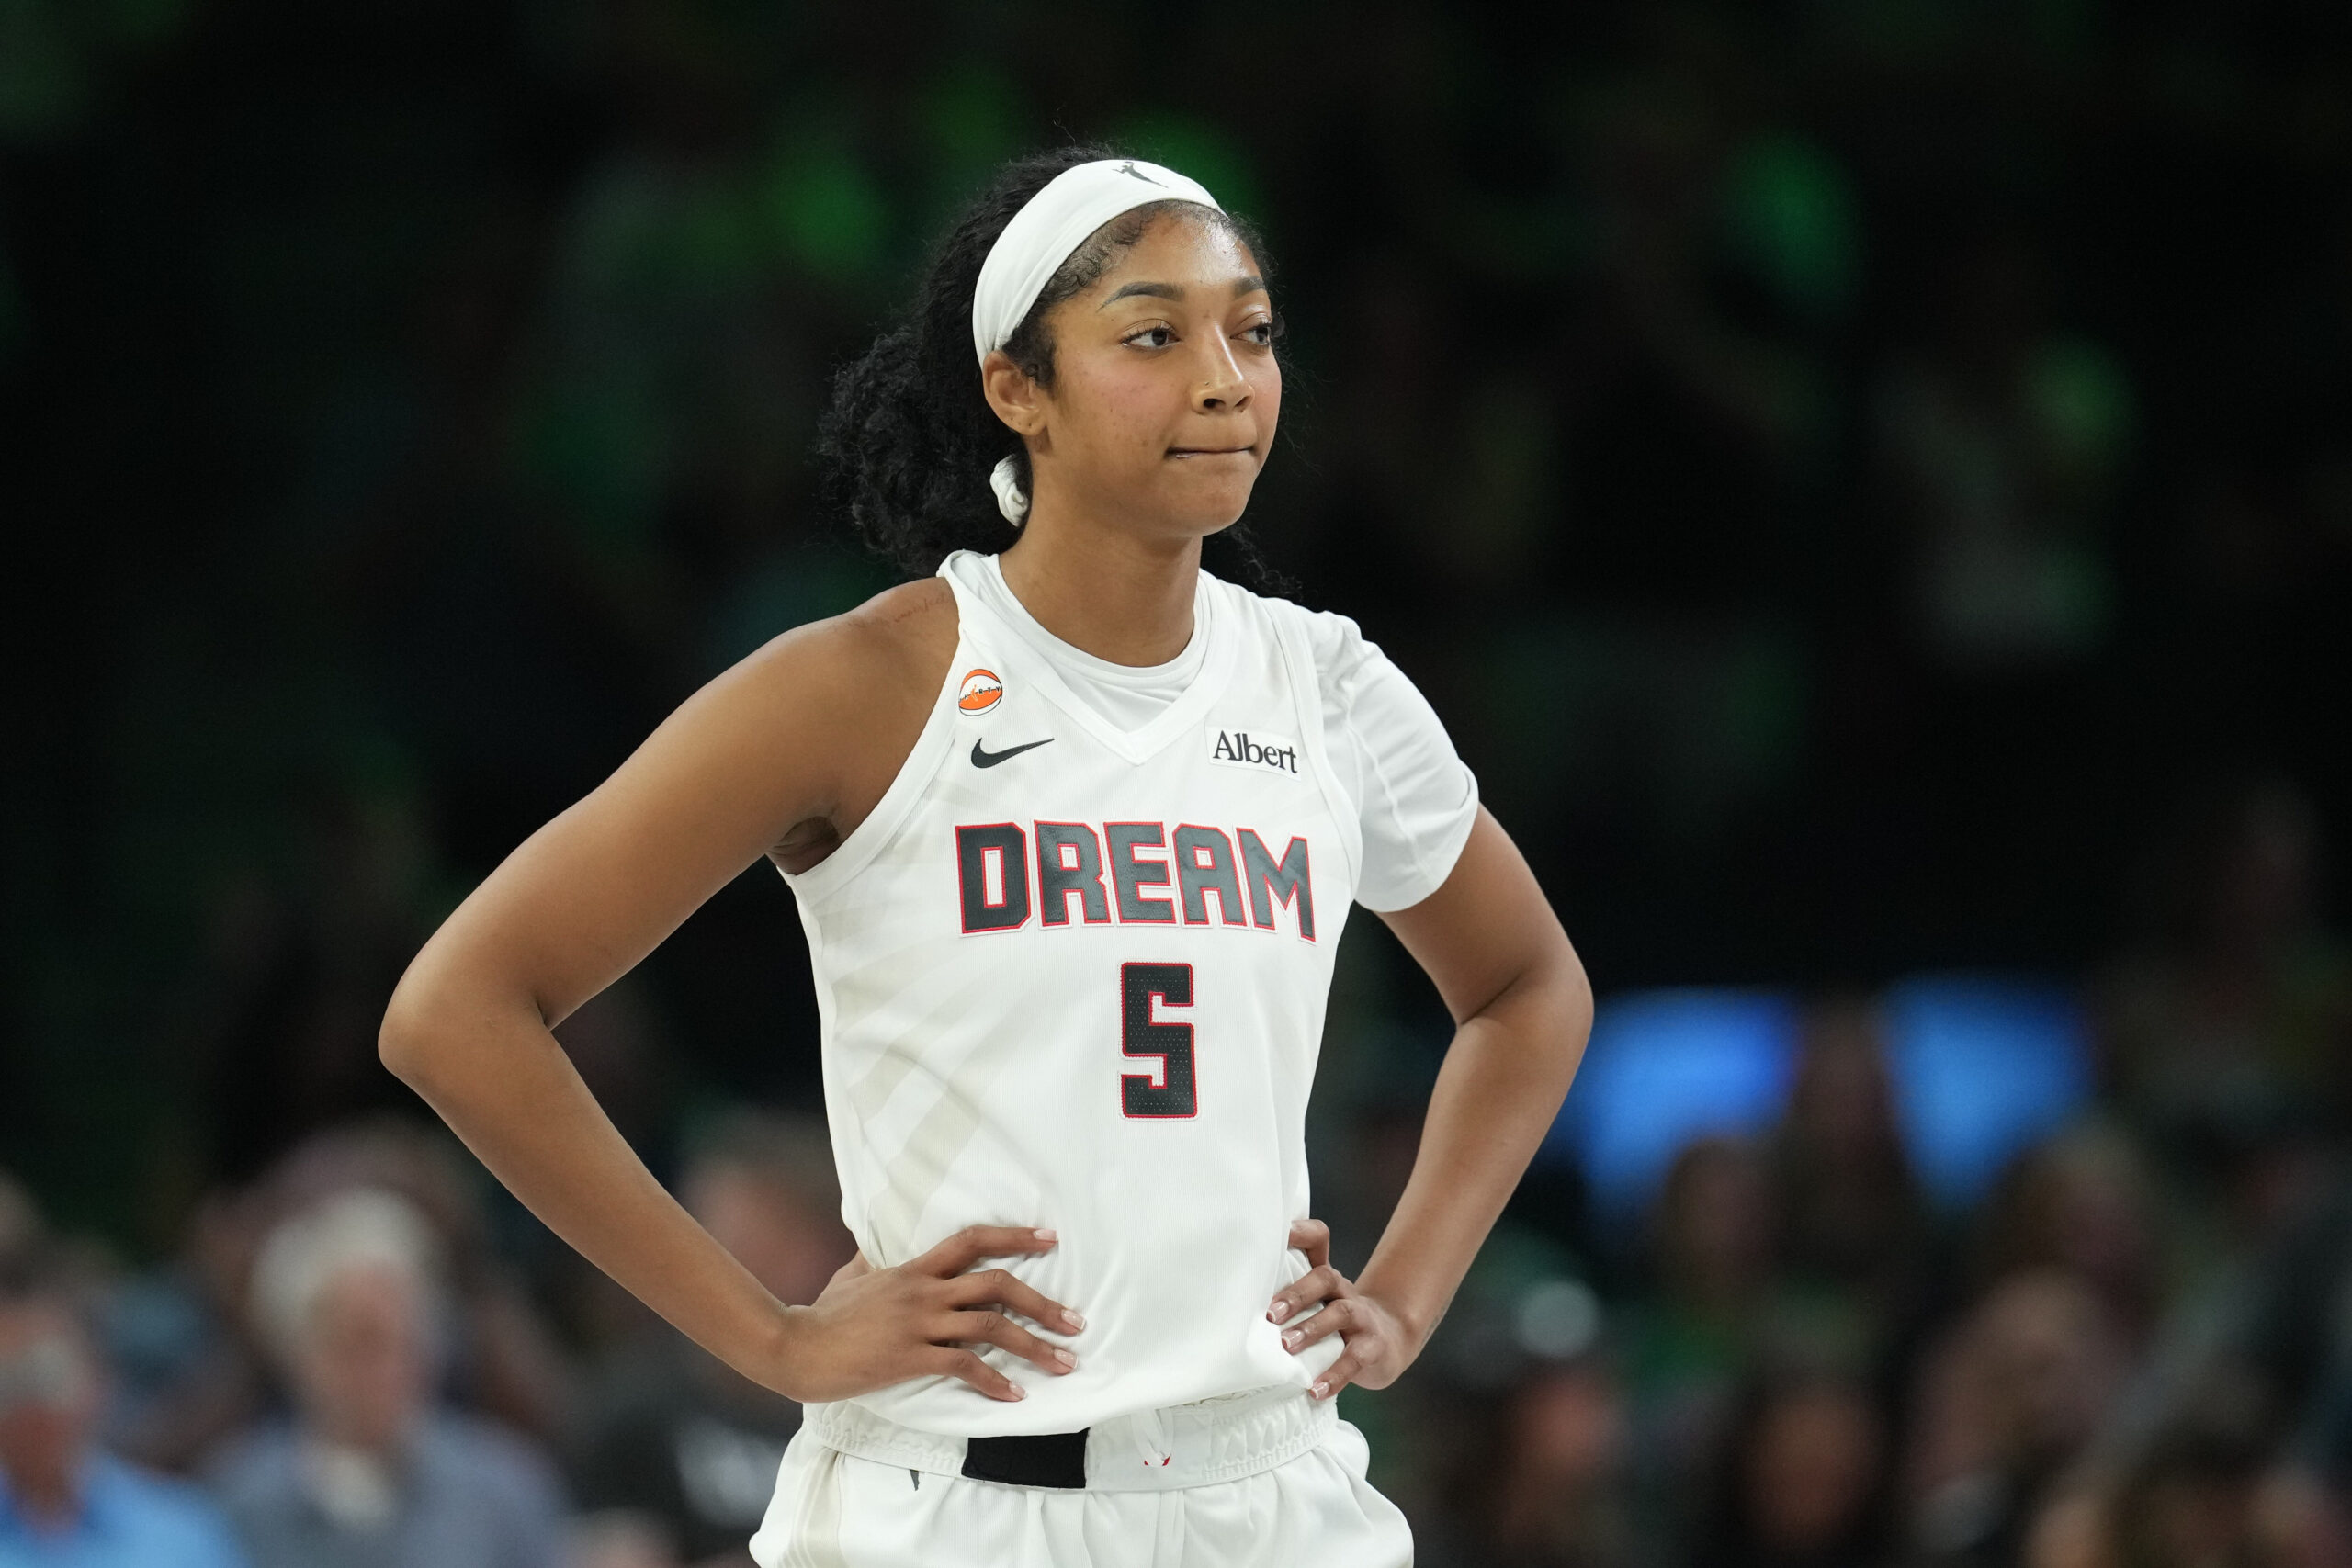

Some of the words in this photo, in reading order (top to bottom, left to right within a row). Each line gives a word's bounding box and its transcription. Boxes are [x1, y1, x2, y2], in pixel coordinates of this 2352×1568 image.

[1213, 730, 1297, 773] Albert
[955, 820, 1316, 942] DREAM
[1120, 962, 1197, 1118] 5
